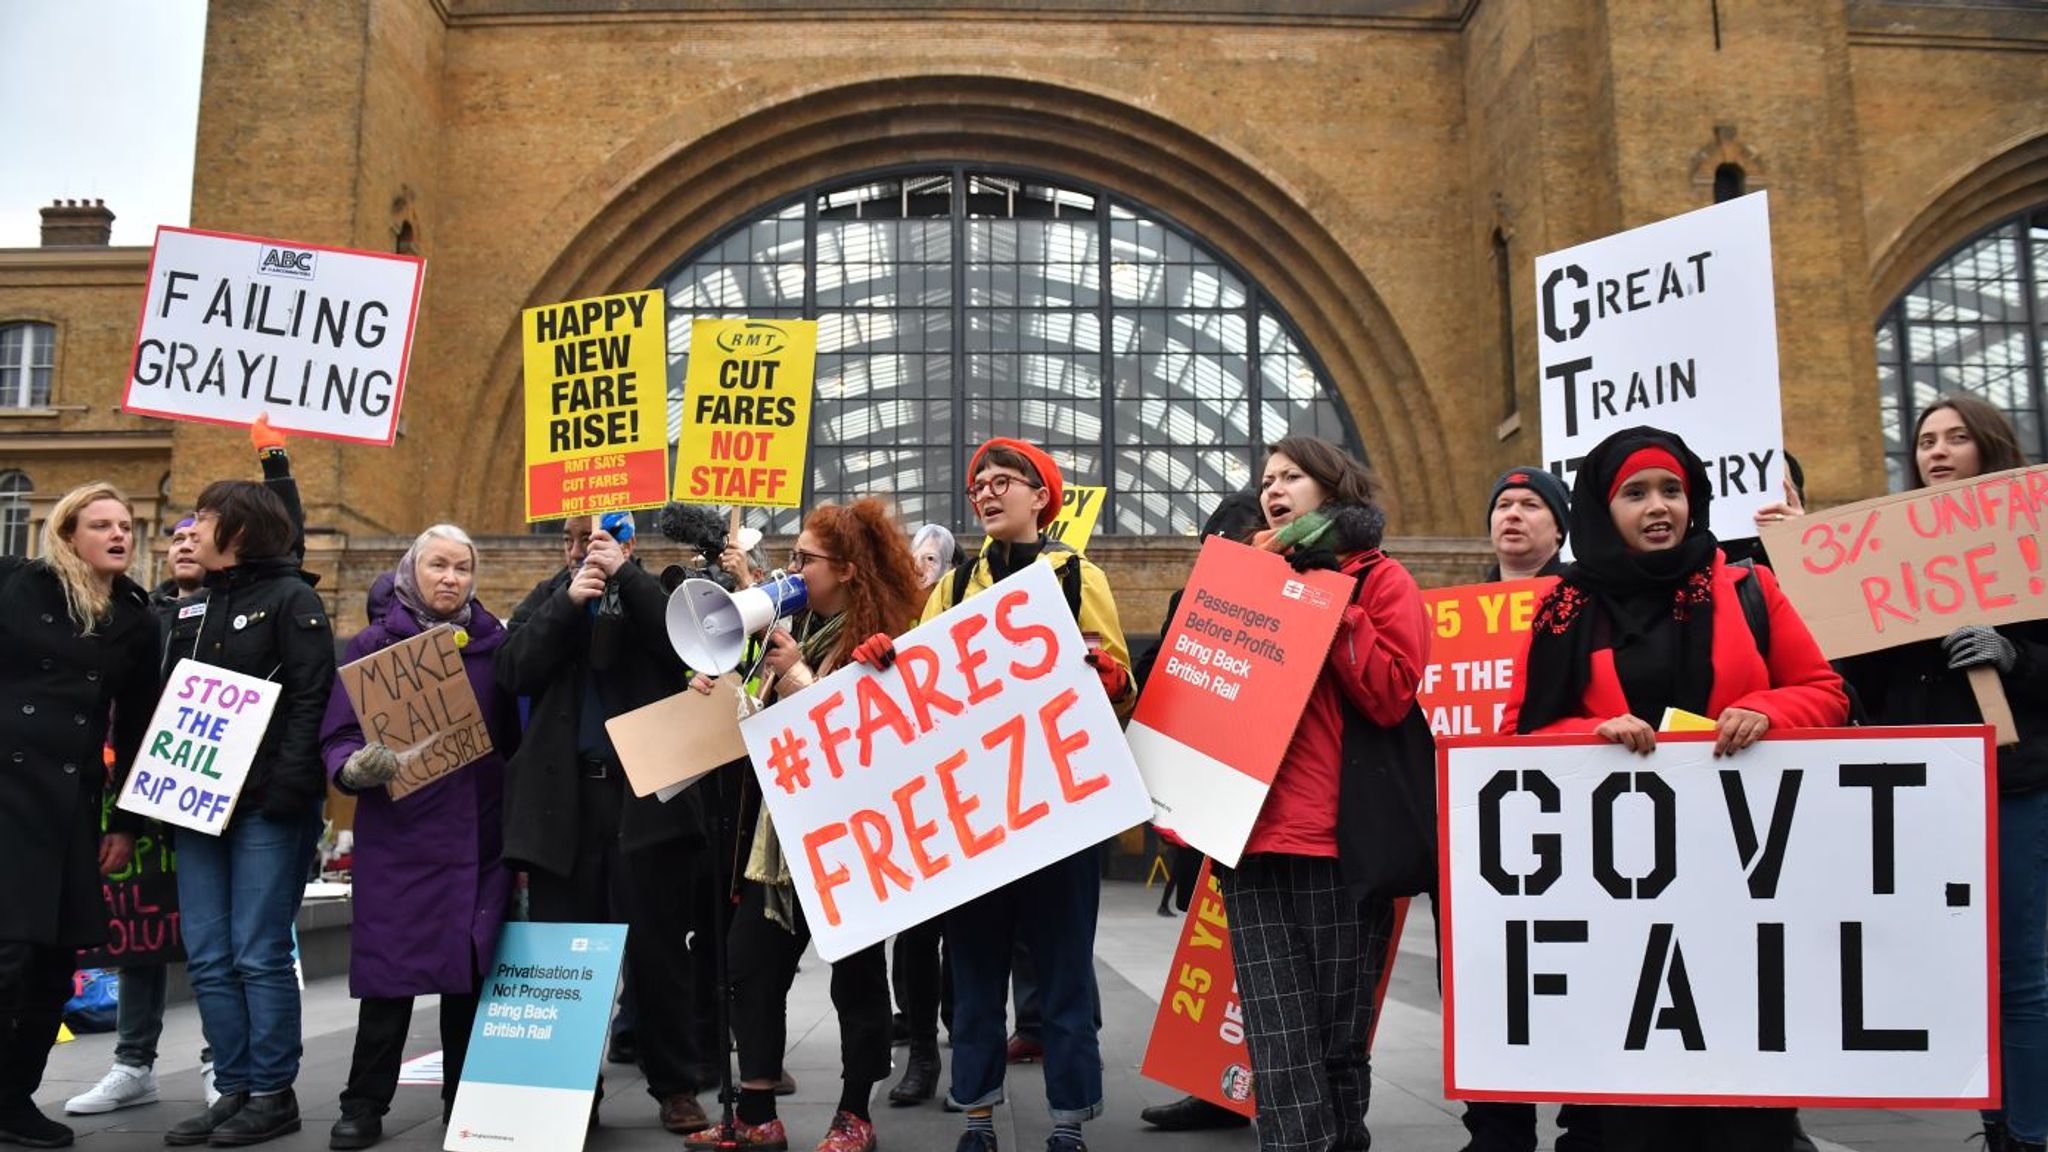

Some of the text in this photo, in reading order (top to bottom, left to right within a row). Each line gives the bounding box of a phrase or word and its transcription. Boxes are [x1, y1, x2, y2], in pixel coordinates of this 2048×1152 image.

[263, 249, 312, 271] ABC
[161, 270, 388, 348] FAILING
[536, 294, 649, 343] HAPPY
[1542, 251, 1712, 343] GREAT
[554, 334, 632, 378] NEW
[731, 333, 776, 347] RMT
[134, 339, 393, 417] GRAYLING
[551, 372, 638, 416] FARE
[719, 360, 780, 390] CUT
[1545, 356, 1697, 437] TRAIN
[549, 410, 639, 452] RISE!
[695, 395, 796, 427] FARES
[565, 454, 626, 473] RMT SAYS
[710, 430, 774, 461] NOT
[562, 496, 585, 511] NOT
[588, 492, 630, 507] STAFF!
[563, 472, 628, 492] CUT FARES
[690, 466, 787, 498] STAFF
[1801, 510, 1882, 575] 3%
[1861, 535, 2044, 633] RISE!
[1185, 611, 1232, 642] Before
[1195, 588, 1280, 632] Passengers
[1425, 591, 1535, 639] 5 YE
[359, 631, 463, 714] MAKE
[1174, 633, 1252, 679] Bring Back
[1416, 659, 1513, 695] F THE
[177, 676, 261, 714] STOP
[767, 589, 1060, 794] #FARES
[1165, 656, 1241, 702] British Rail
[176, 706, 229, 742] THE
[370, 688, 472, 748] RAIL
[1422, 704, 1482, 736] AIL
[150, 730, 223, 780] RAIL
[131, 770, 231, 822] RIP OFF
[802, 686, 1110, 927] FREEZE
[1478, 762, 1971, 907] GOVT.
[492, 983, 516, 997] Not
[497, 963, 593, 981] Privatisation is
[1172, 963, 1212, 1023] 25
[1505, 920, 1929, 1052] FAIL
[483, 1022, 553, 1040] British Rail
[488, 1002, 558, 1020] Bring Back
